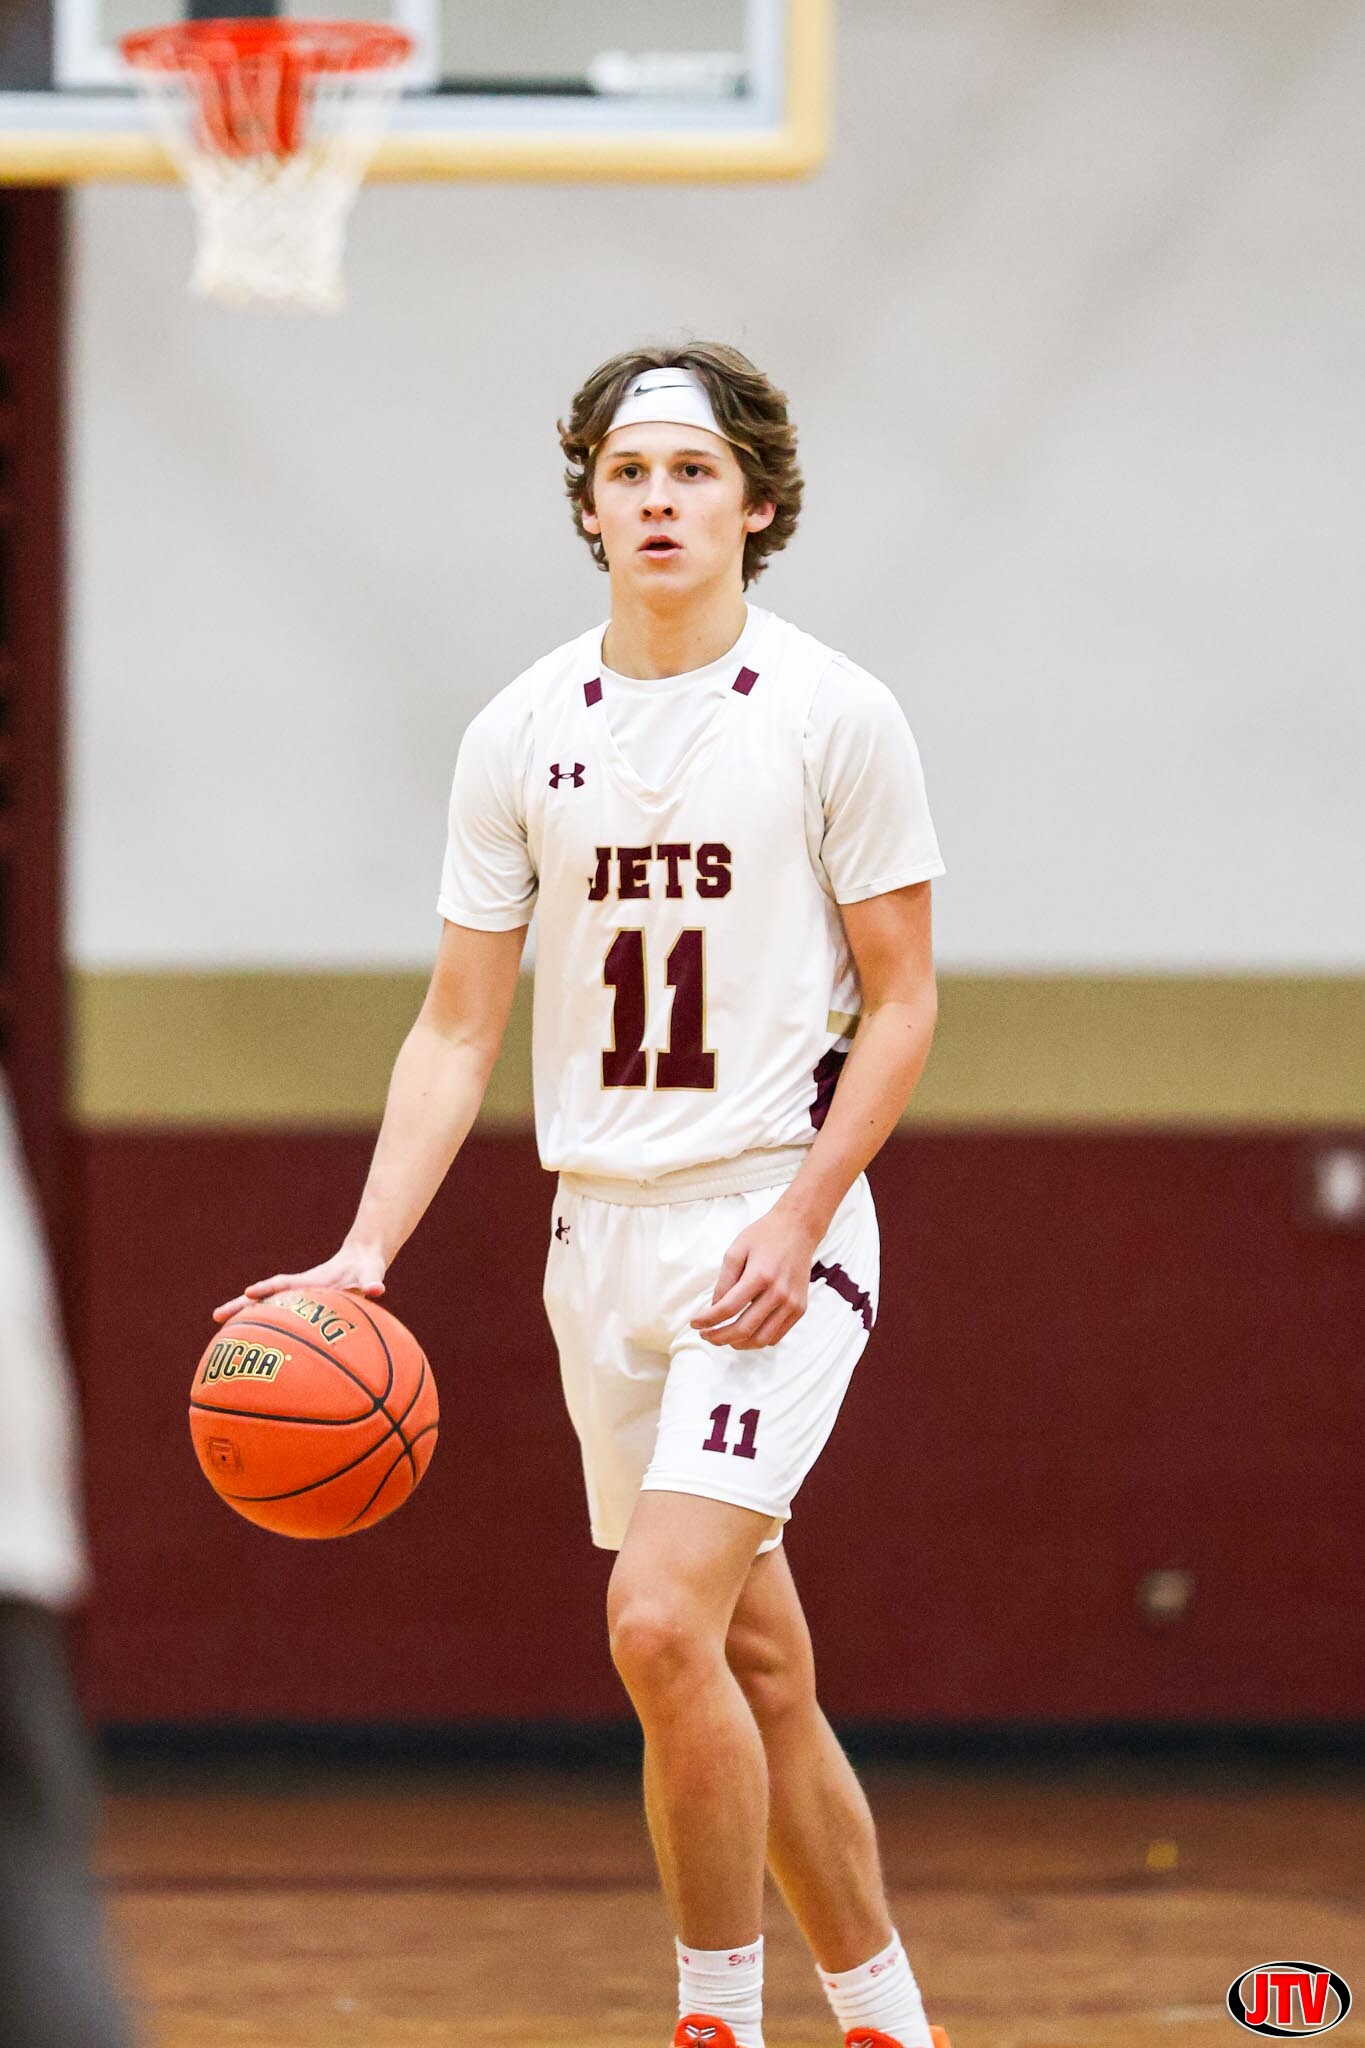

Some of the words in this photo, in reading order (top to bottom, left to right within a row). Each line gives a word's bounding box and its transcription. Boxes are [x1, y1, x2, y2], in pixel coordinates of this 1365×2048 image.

[588, 843, 732, 901] JETS
[601, 927, 718, 1092] 11
[702, 1404, 761, 1460] 11
